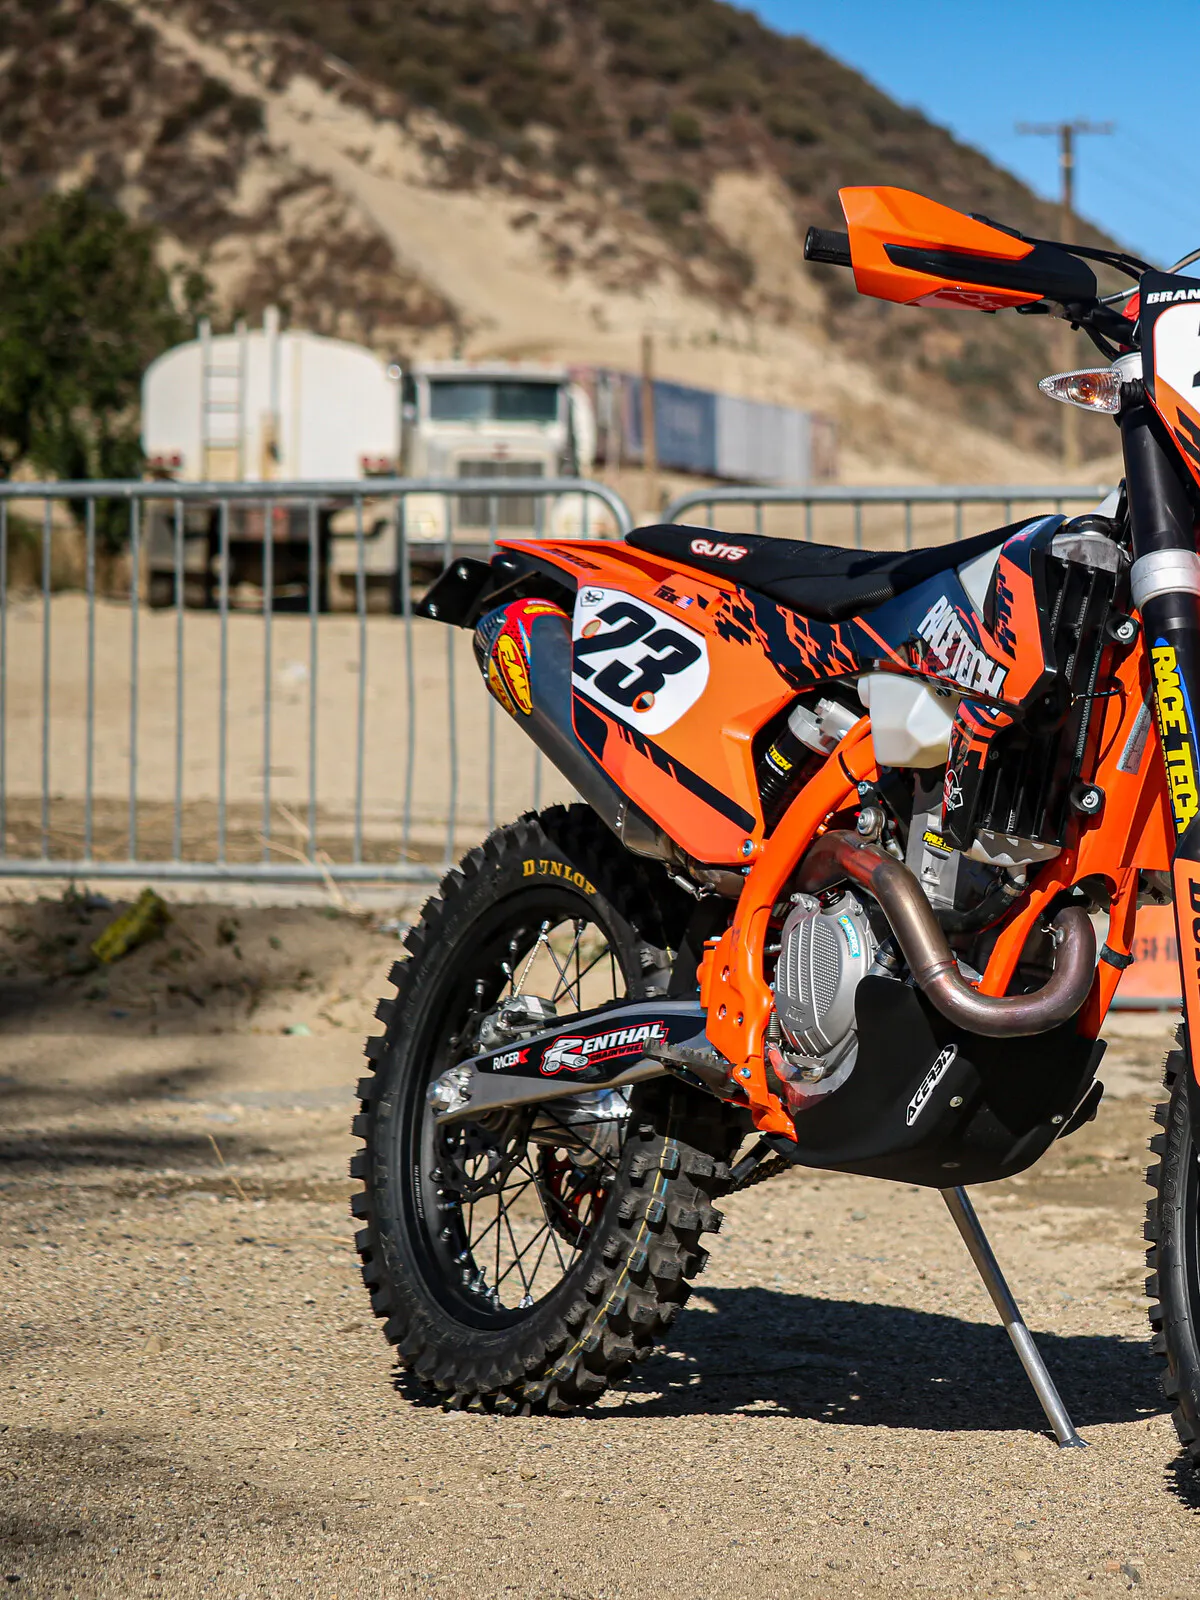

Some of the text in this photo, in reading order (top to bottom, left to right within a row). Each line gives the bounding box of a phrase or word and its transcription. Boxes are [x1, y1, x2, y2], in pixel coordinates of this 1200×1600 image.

[691, 538, 748, 561] GUTS
[572, 601, 702, 708] 23
[1151, 646, 1188, 736] RACE
[523, 859, 598, 896] DUNLOP
[542, 1024, 665, 1072] RENTHAL
